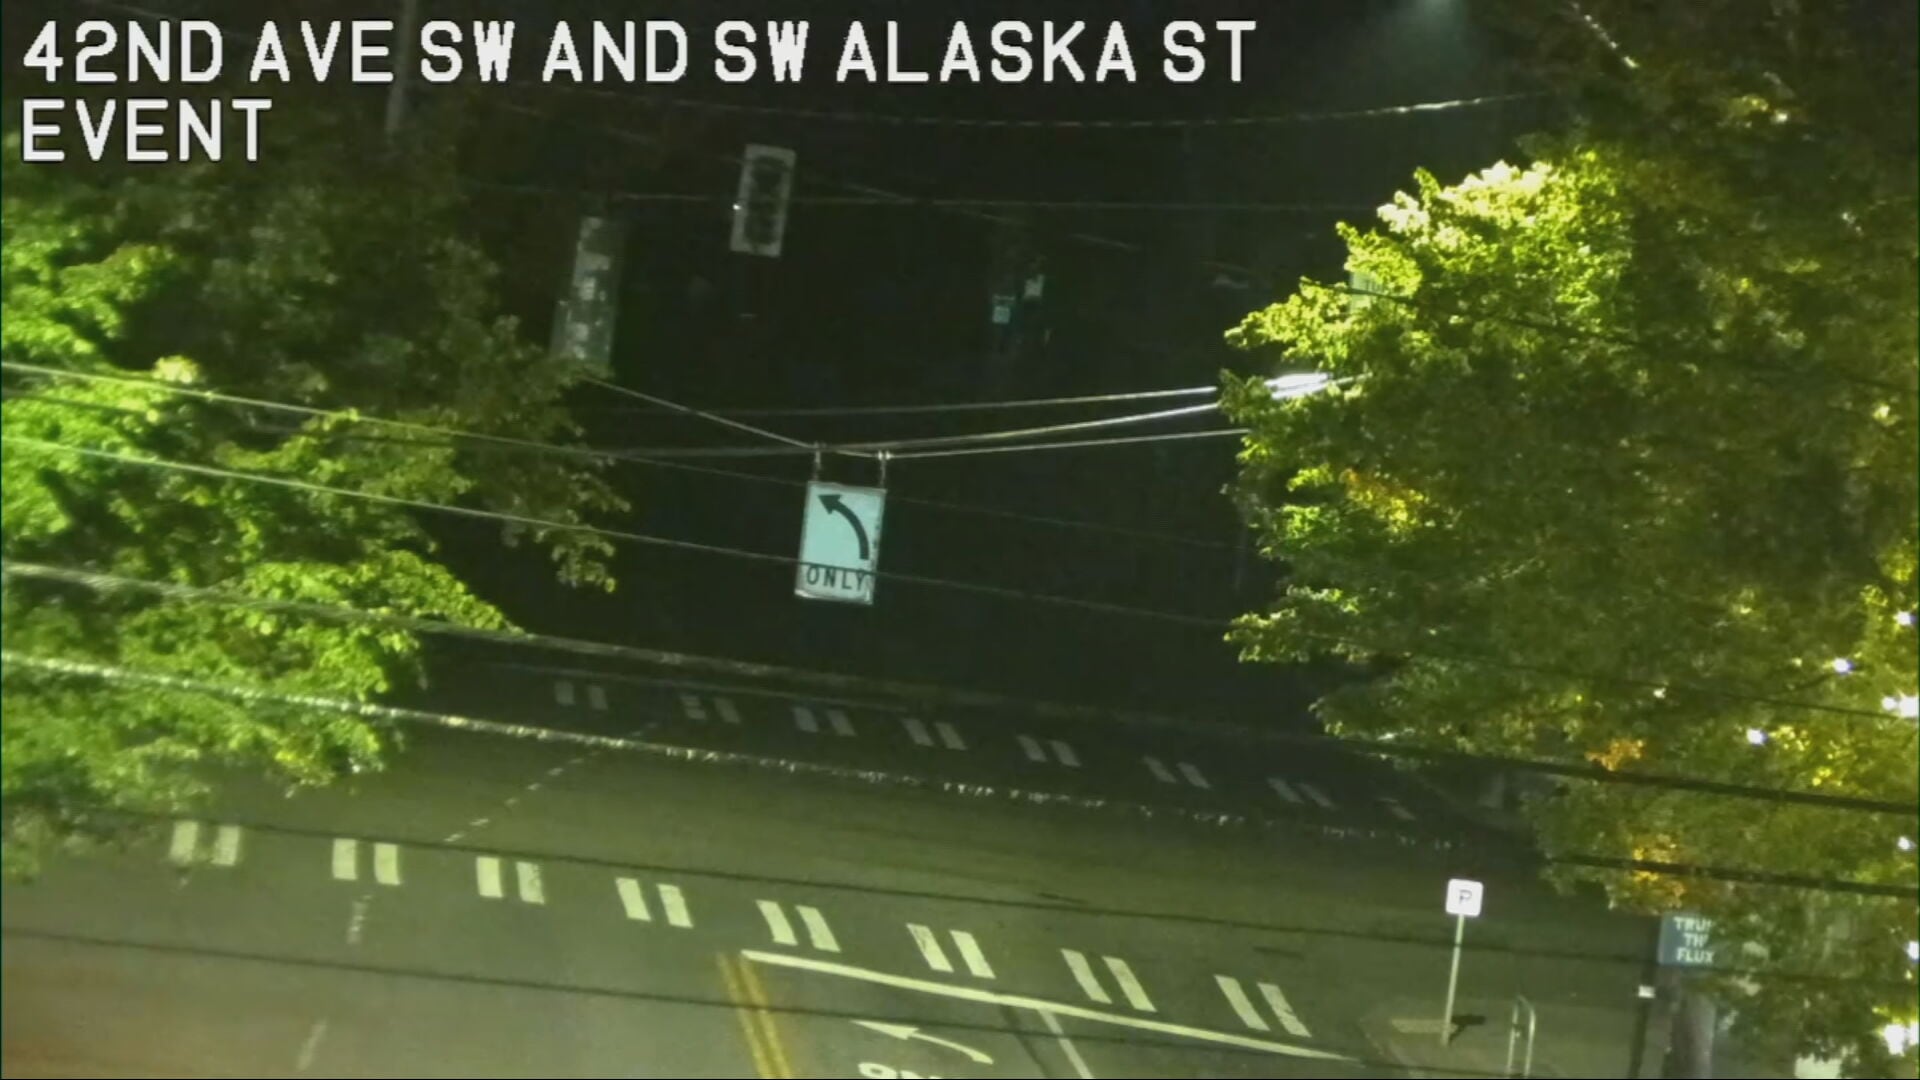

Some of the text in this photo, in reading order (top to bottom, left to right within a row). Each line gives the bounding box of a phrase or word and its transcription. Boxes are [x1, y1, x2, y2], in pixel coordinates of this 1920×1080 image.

[805, 566, 867, 592] ONLY
[1458, 888, 1473, 905] P
[1675, 946, 1715, 963] FLUX
